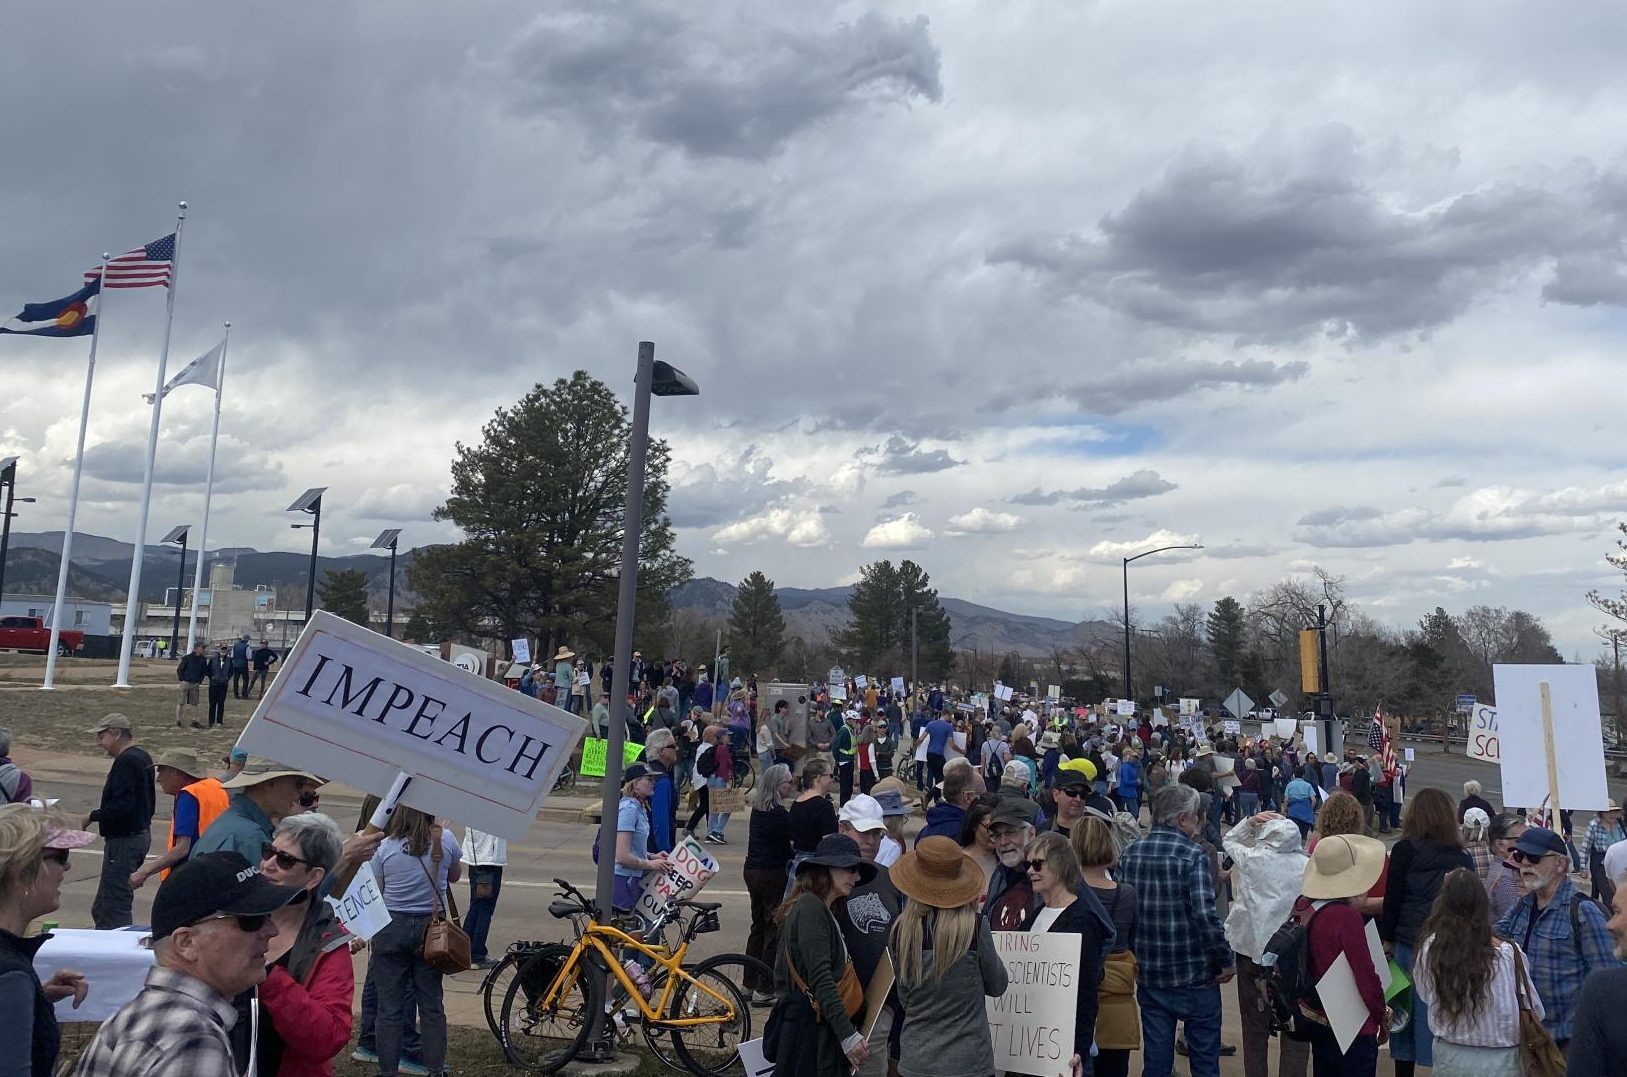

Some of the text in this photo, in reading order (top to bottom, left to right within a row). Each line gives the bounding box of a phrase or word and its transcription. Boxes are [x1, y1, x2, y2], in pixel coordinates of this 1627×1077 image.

[296, 653, 553, 781] IMPEACH
[236, 865, 259, 883] DUC
[654, 876, 671, 896] PA
[667, 867, 694, 891] EEP
[335, 878, 380, 925] IENCE
[643, 894, 664, 916] OU
[1007, 961, 1073, 988] SCIENTISTS
[993, 993, 1032, 1014] WILL
[1009, 1024, 1061, 1060] LIVES
